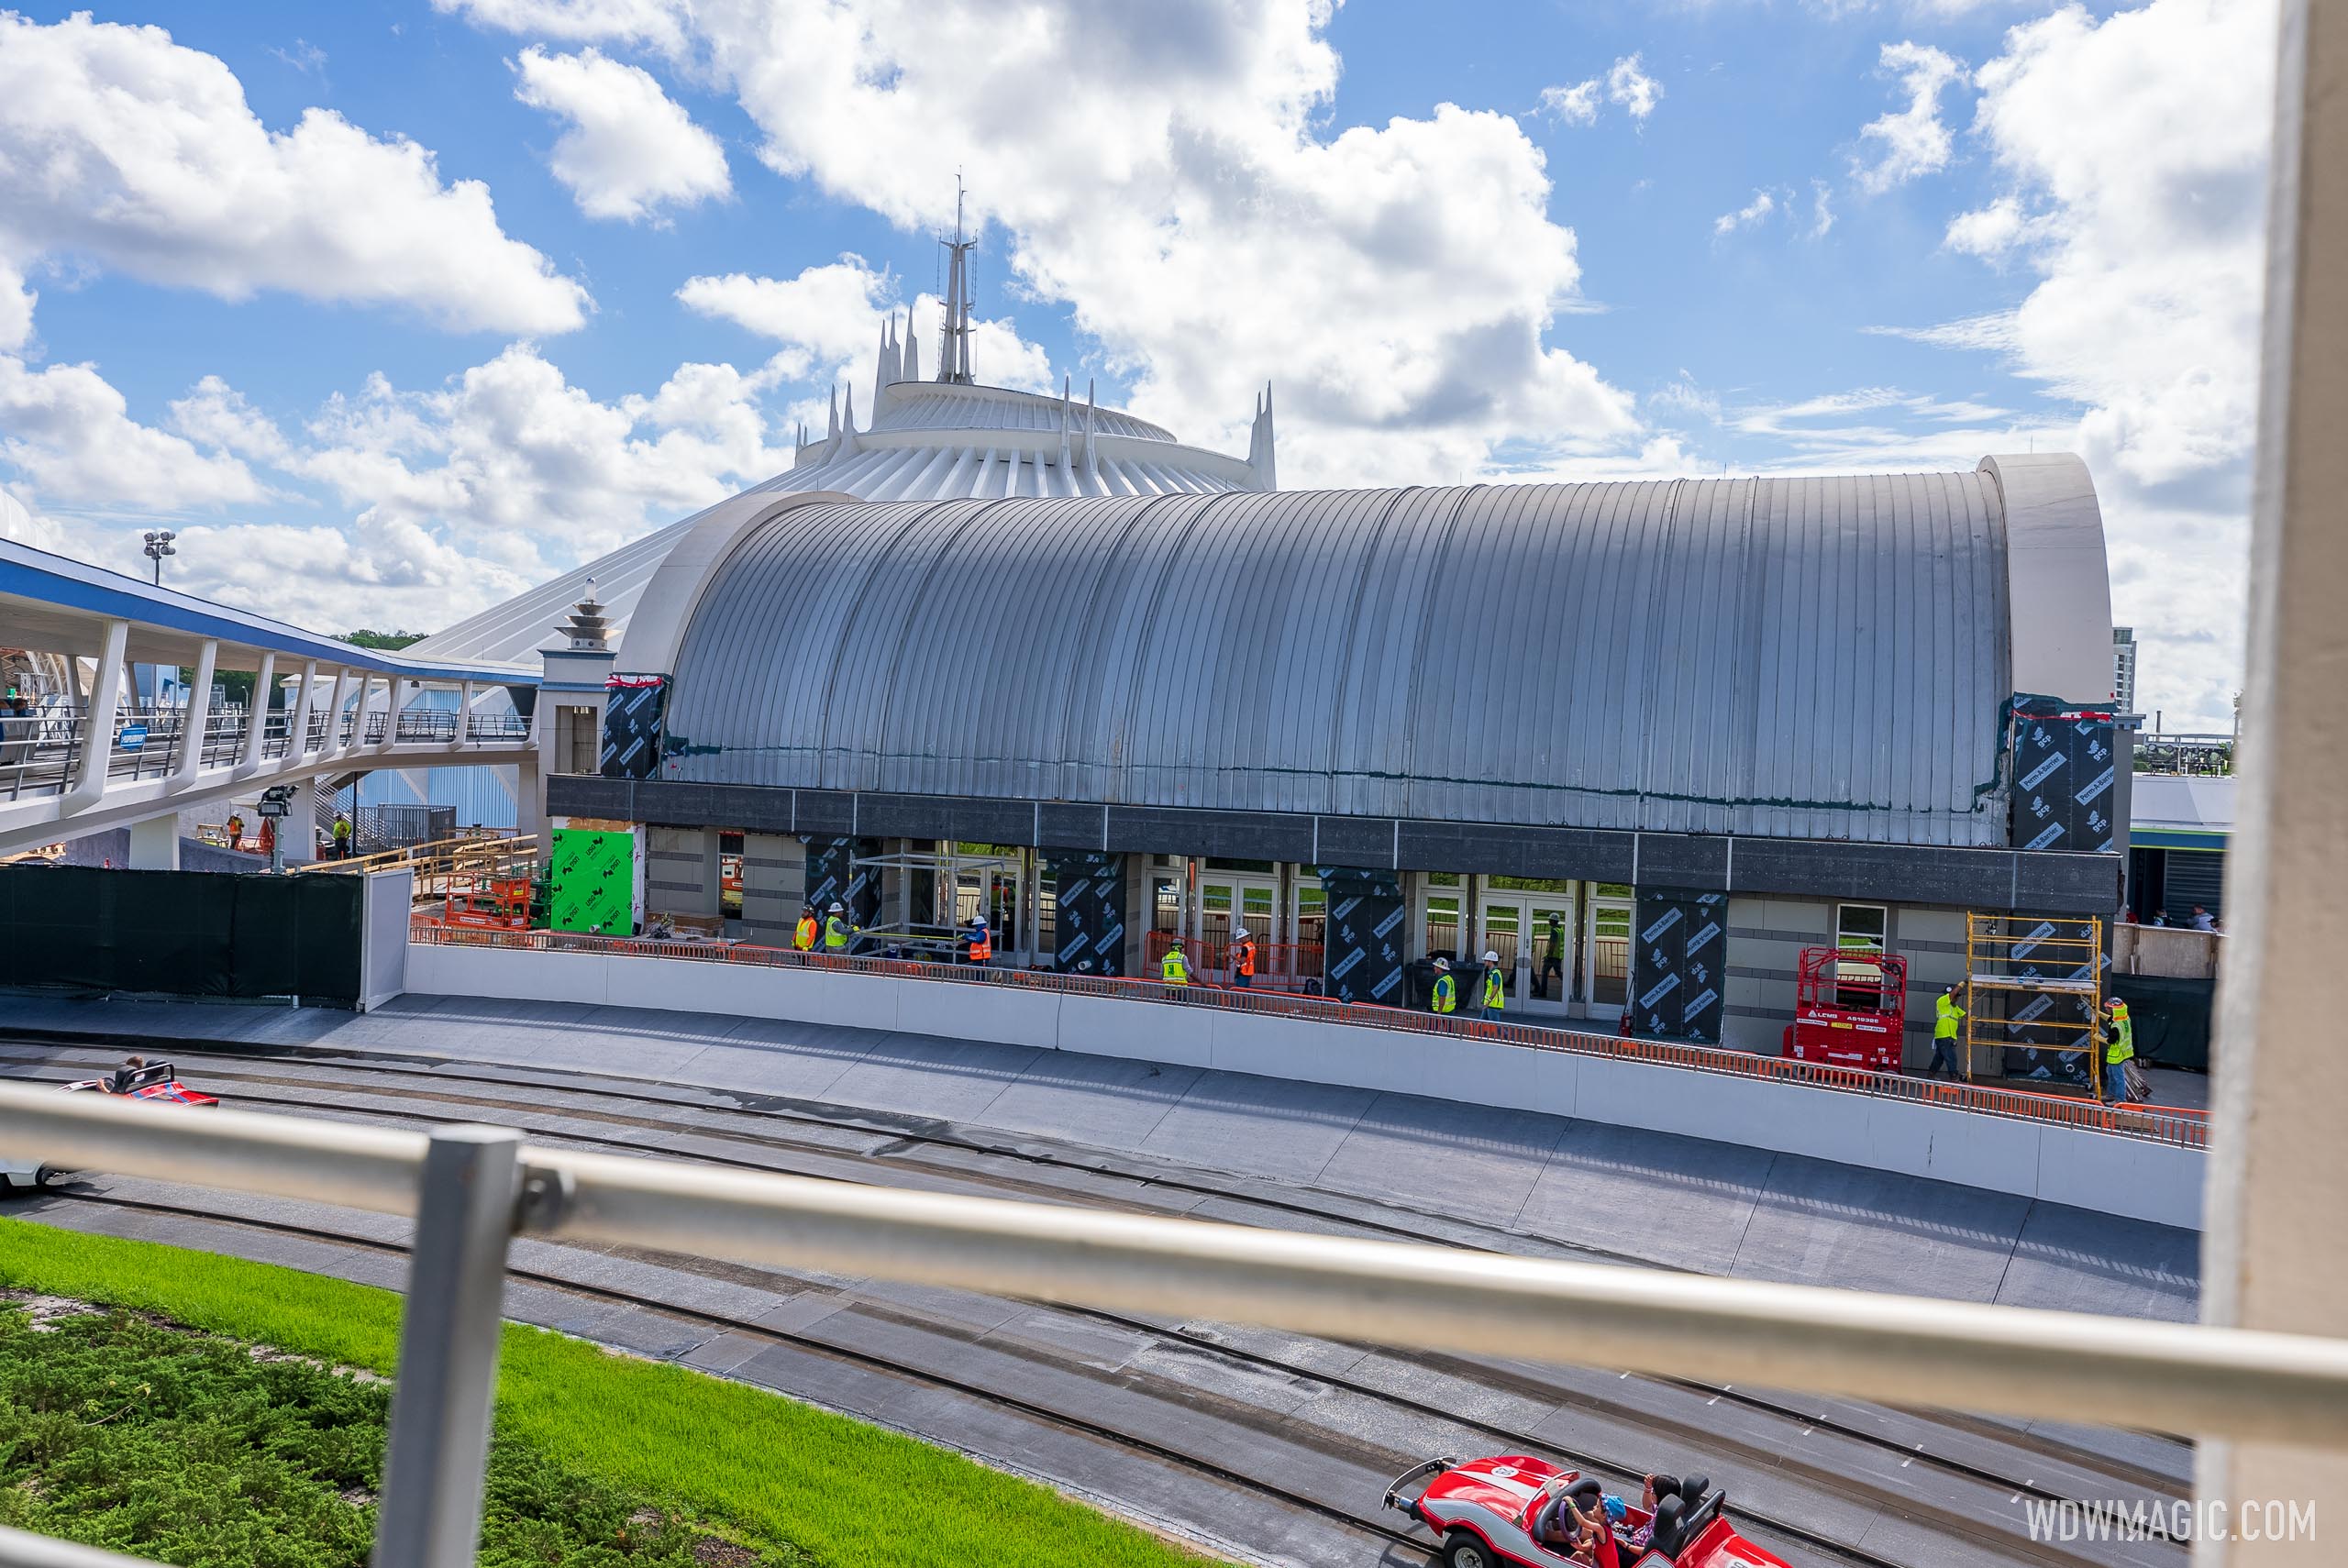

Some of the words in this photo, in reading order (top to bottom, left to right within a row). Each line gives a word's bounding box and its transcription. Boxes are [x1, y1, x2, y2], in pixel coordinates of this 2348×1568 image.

[2037, 734, 2052, 748] gcp
[2093, 747, 2107, 762] gcp
[2023, 756, 2060, 787] Perm-A-Barrier
[2036, 803, 2050, 818] gcp
[2092, 818, 2107, 834] gcp
[586, 844, 596, 856] USG
[610, 858, 621, 871] USG
[585, 894, 596, 907] USG
[610, 910, 621, 922] USG
[1645, 910, 1678, 939] Perm-A-Barrier
[1656, 955, 1668, 969] gcp
[1644, 977, 1675, 1005] Perm-A-Barrier
[1654, 1021, 1667, 1034] gcp
